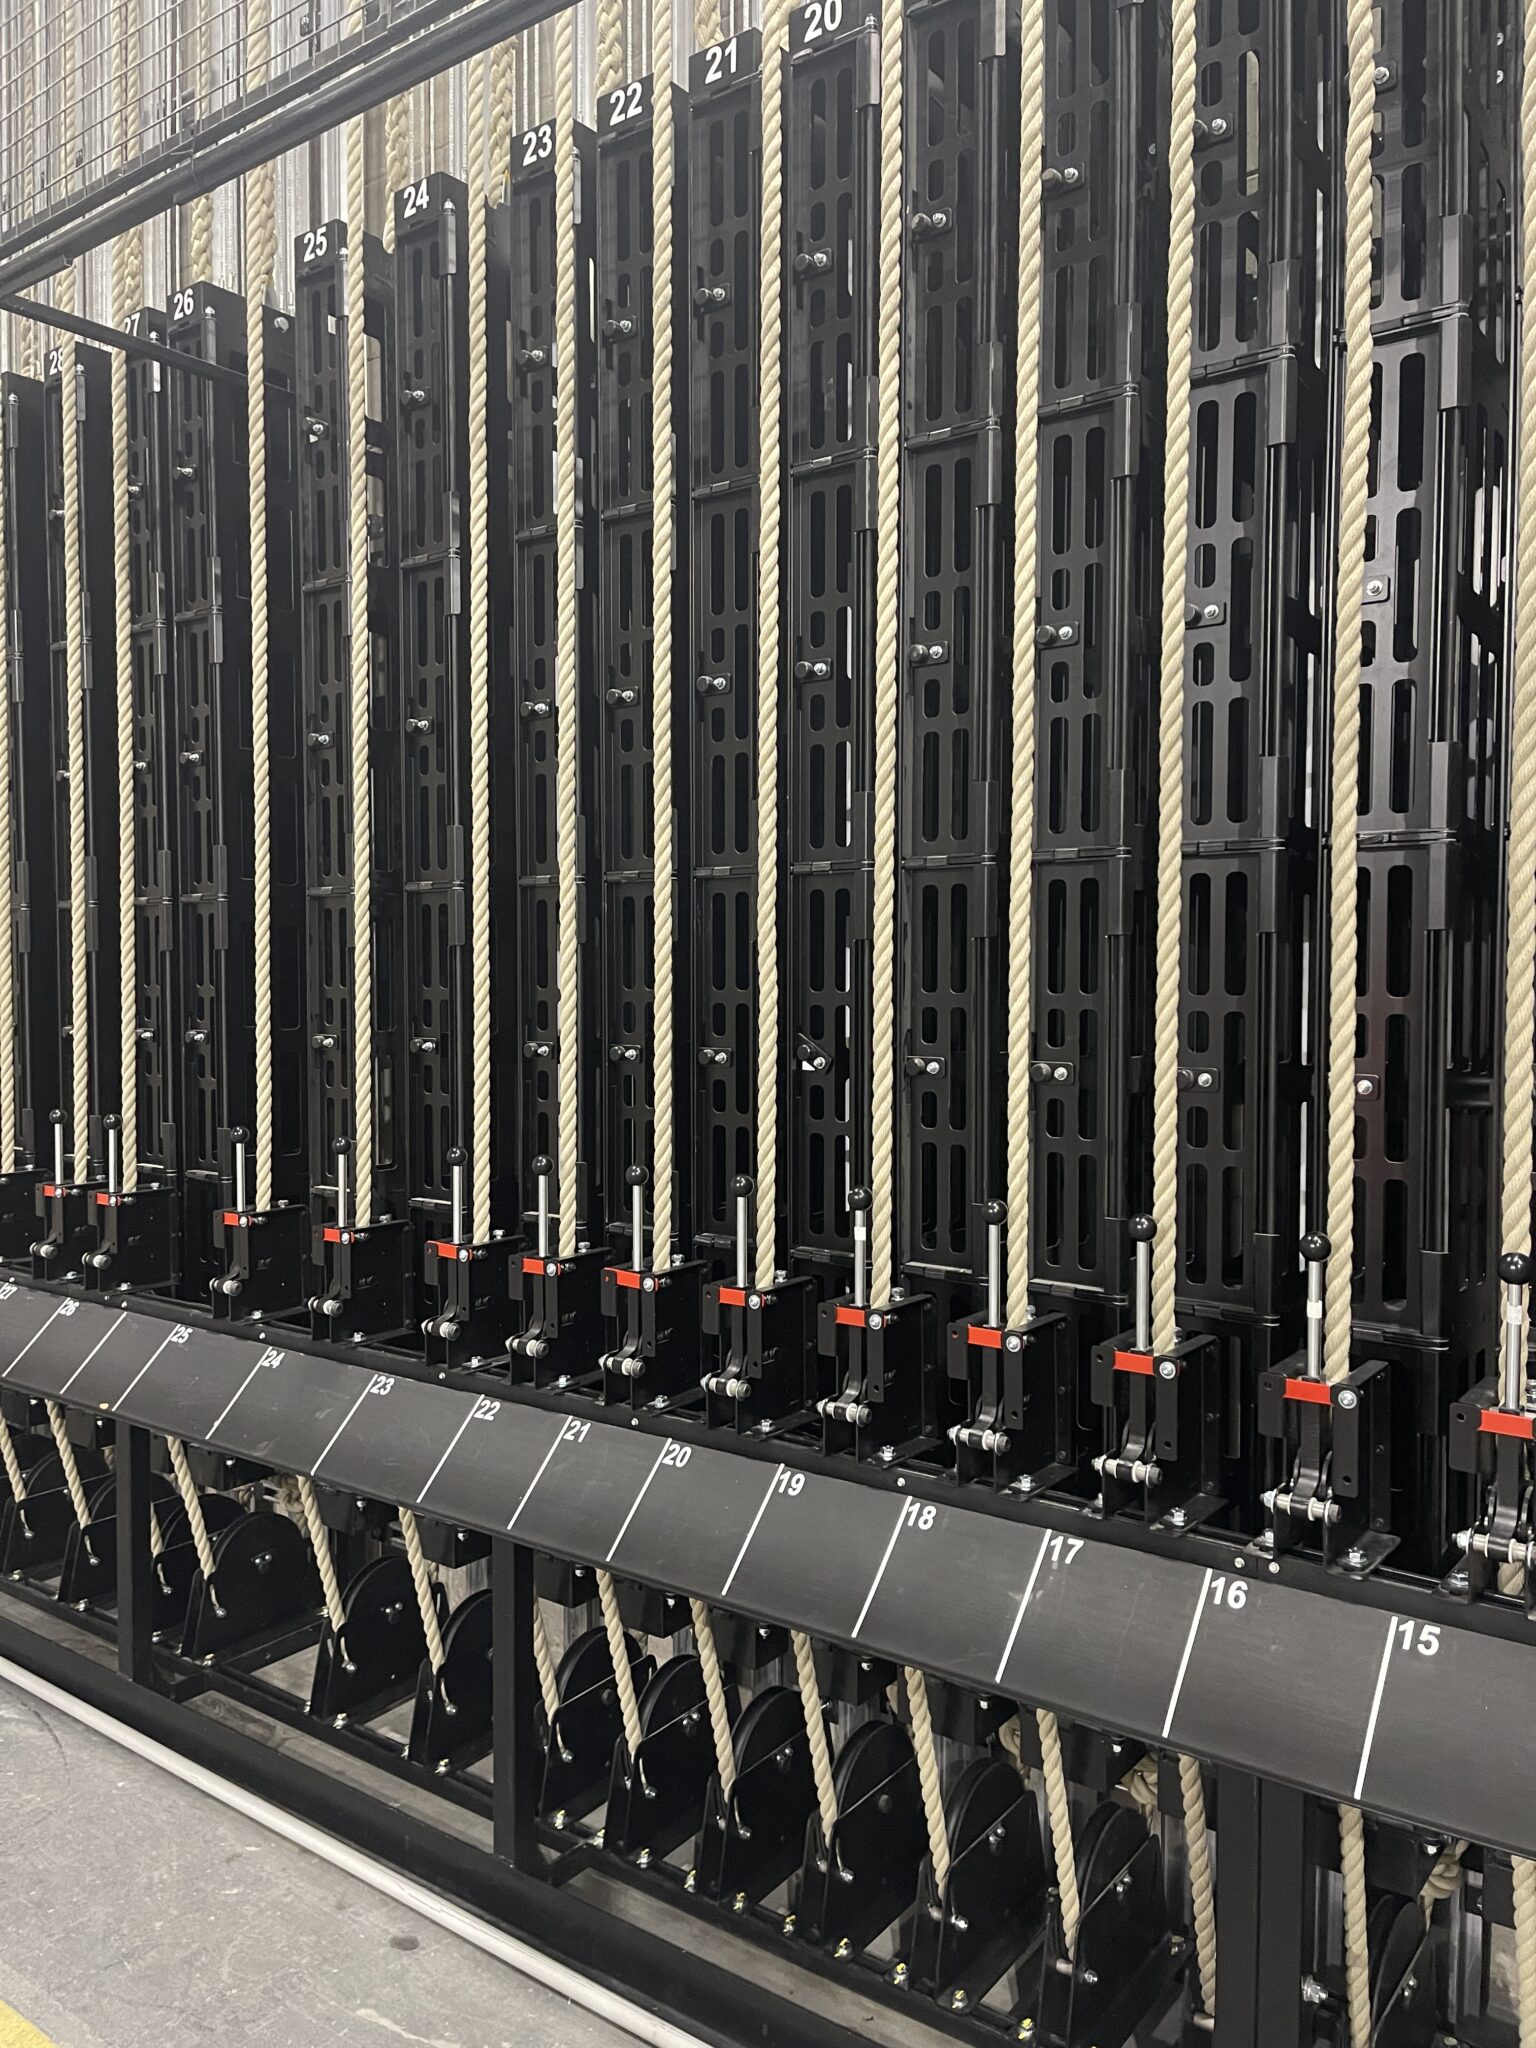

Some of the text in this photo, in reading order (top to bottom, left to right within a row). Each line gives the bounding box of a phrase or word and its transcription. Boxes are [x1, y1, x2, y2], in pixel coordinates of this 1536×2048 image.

[803, 0, 842, 43] 20
[705, 37, 737, 84] 21
[609, 81, 643, 126] 22
[522, 124, 552, 167] 23
[403, 178, 430, 219] 24
[303, 226, 327, 262] 25
[173, 288, 194, 320] 26
[0, 1285, 18, 1300] 27
[59, 1300, 80, 1317] 26
[171, 1326, 194, 1344] 25
[262, 1350, 286, 1369] 24
[370, 1375, 396, 1396] 23
[474, 1400, 501, 1421] 22
[563, 1420, 592, 1443] 21
[662, 1444, 692, 1468] 20
[777, 1470, 806, 1497] 19
[907, 1502, 937, 1531] 18
[1050, 1536, 1085, 1565] 17
[1212, 1577, 1249, 1610] 16
[1399, 1620, 1442, 1656] 15
